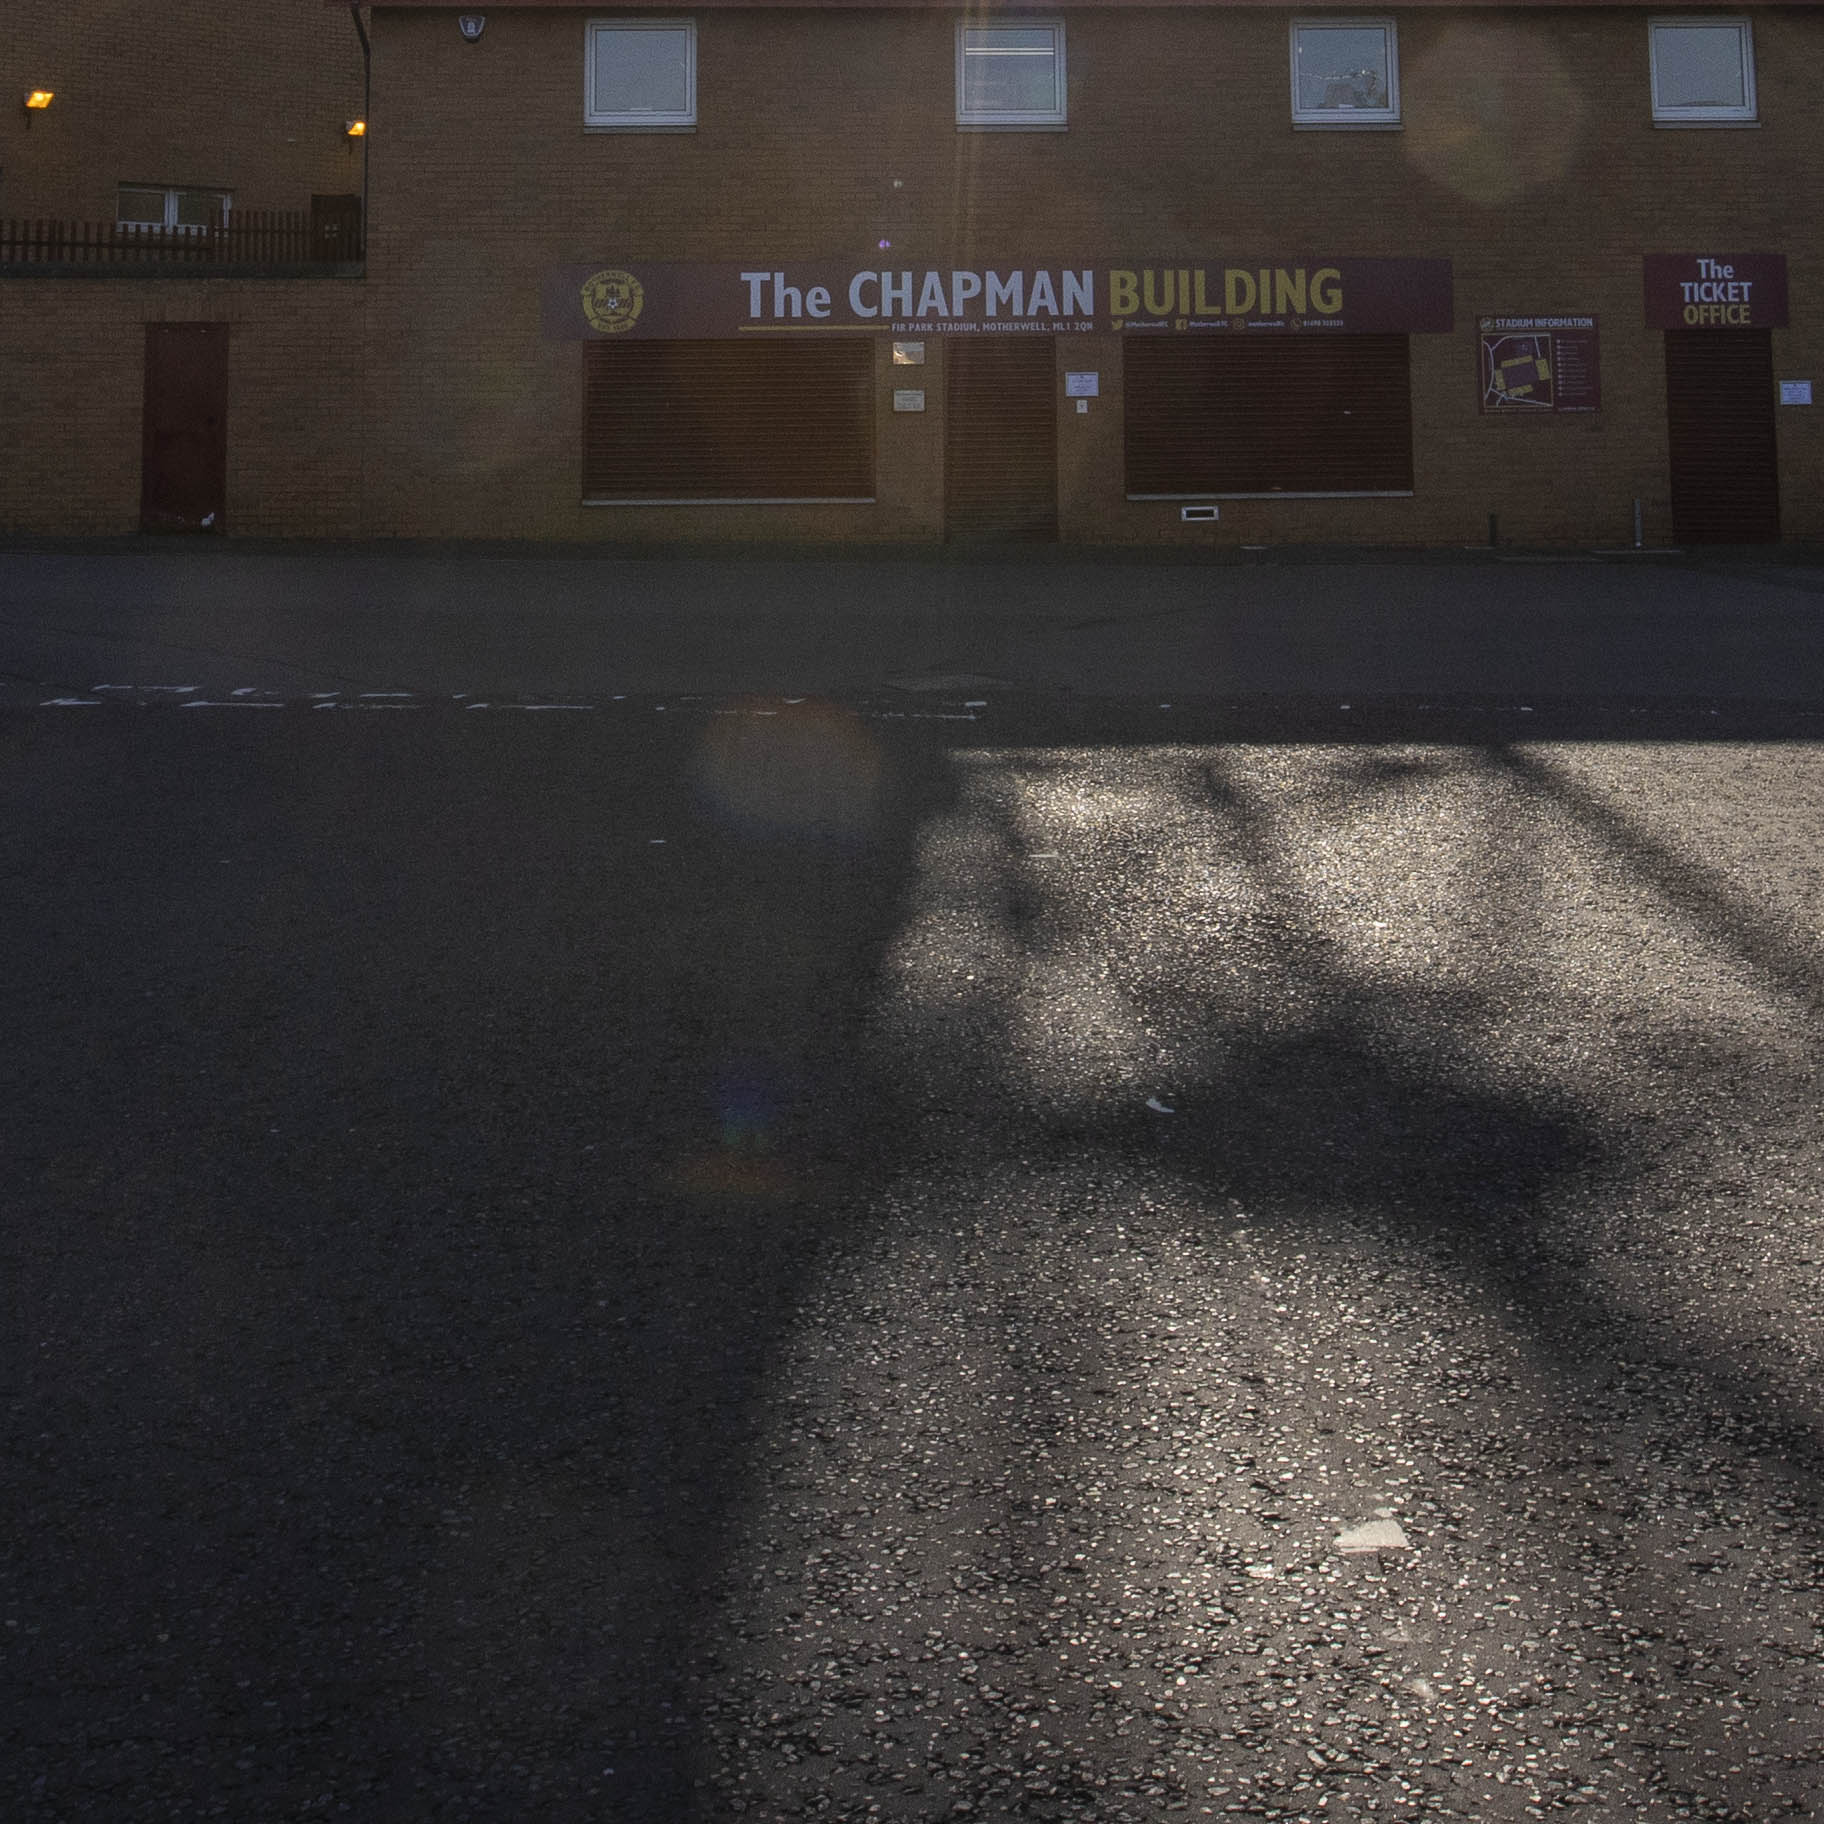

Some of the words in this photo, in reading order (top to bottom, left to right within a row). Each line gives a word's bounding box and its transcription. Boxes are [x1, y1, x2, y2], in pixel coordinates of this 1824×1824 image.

[1696, 258, 1734, 279] The
[740, 272, 831, 318] The
[848, 269, 1094, 318] CHAPMAN
[1109, 268, 1344, 316] BUILDING
[1680, 282, 1752, 303] TICKET
[1496, 318, 1534, 328] STADIUM
[1535, 318, 1593, 327] INFORMATION
[1683, 304, 1751, 325] OFFICE
[892, 322, 907, 332] FIR
[908, 322, 934, 332] PARK
[936, 322, 980, 332] STADIUM,
[982, 322, 1050, 332] MOTHERWELL,
[1052, 322, 1072, 332] ML1
[1074, 321, 1093, 332] 2QN
